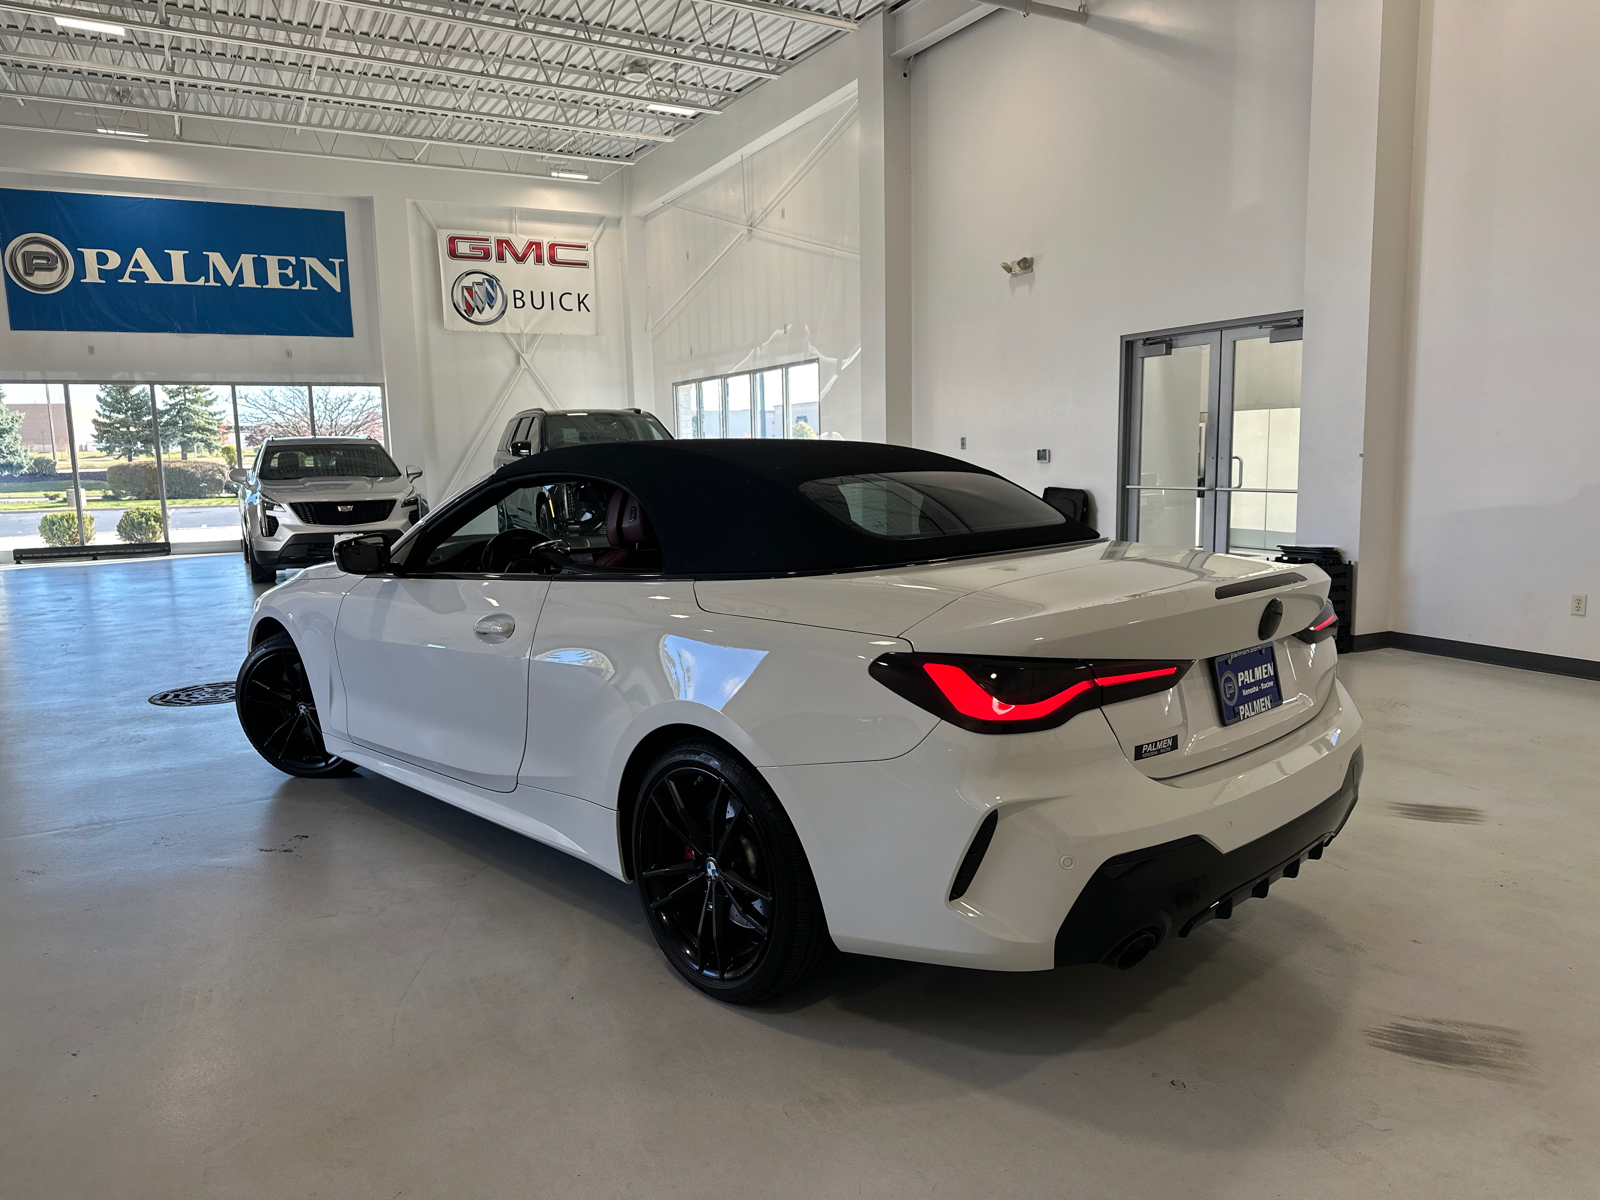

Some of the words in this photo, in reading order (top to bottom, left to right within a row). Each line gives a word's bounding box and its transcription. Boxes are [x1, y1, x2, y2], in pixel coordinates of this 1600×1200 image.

[446, 234, 590, 268] GMC
[77, 247, 344, 293] PALMEN
[513, 290, 591, 312] BUICK
[1238, 662, 1274, 687] PALMEN
[1242, 687, 1259, 696] Kenosha
[1239, 696, 1271, 720] PALMEN
[1142, 738, 1173, 754] PALMEN
